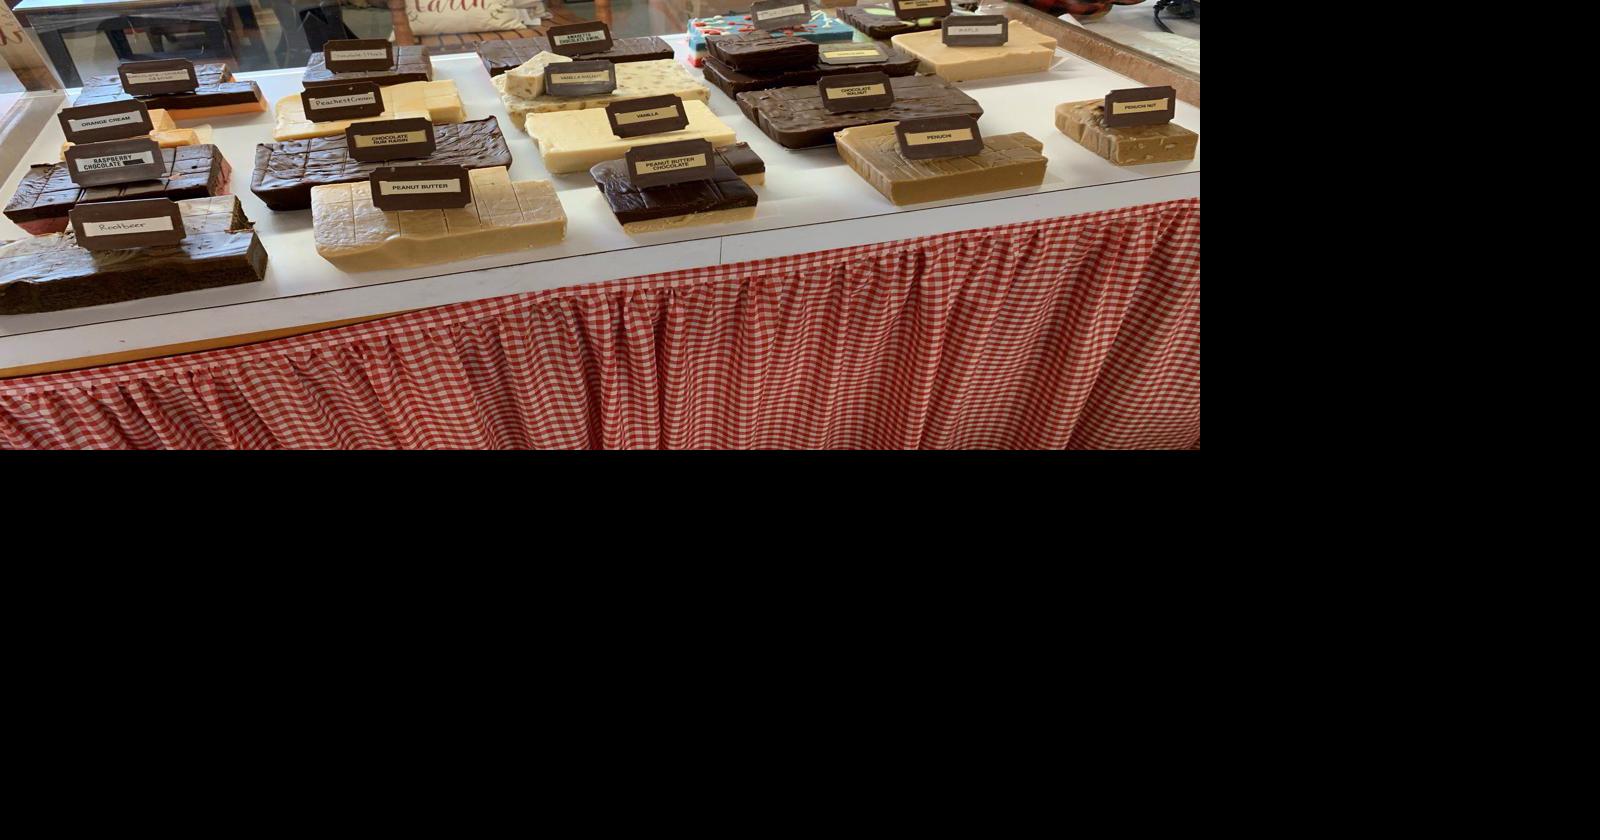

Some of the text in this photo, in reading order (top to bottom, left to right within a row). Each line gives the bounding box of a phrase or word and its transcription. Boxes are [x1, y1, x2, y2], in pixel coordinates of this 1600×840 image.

[81, 119, 107, 127] ORANGE
[93, 155, 132, 164] RASPBERRY
[671, 157, 695, 165] BUTTER
[83, 161, 121, 170] CHOCOLATE
[652, 162, 689, 171] CHOCOLATE
